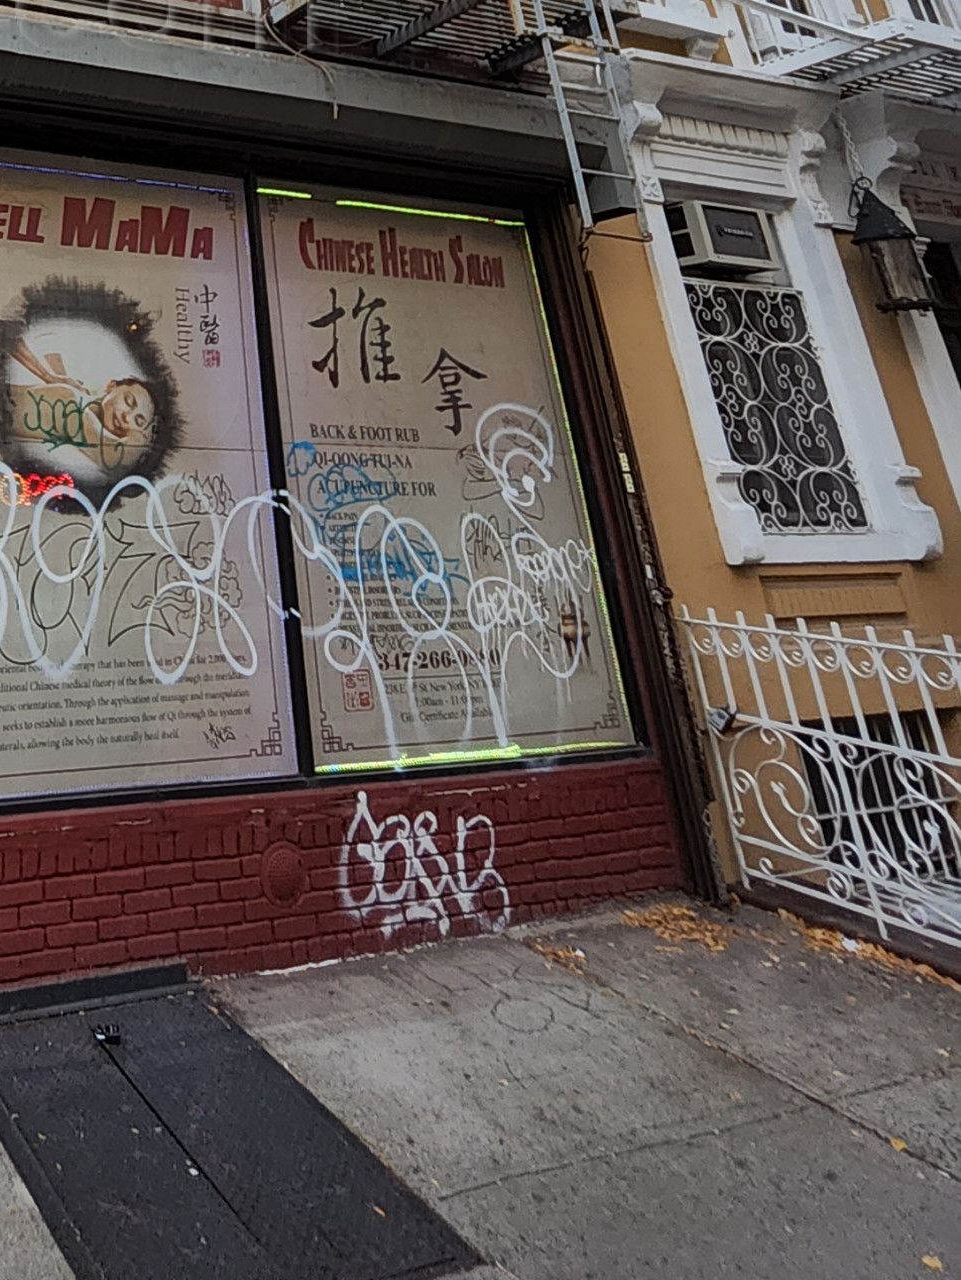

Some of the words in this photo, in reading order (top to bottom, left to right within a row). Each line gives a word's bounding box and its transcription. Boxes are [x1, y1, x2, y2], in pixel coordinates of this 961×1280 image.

[173, 288, 193, 364] Healthy
[308, 287, 488, 436] 推拿
[310, 424, 344, 438] BACK
[348, 426, 357, 439] &
[360, 426, 395, 441] FOOT
[396, 428, 419, 442] RUB
[412, 482, 437, 497] FOR
[98, 659, 112, 668] that
[114, 658, 126, 668] has
[127, 657, 144, 667] been
[164, 658, 172, 666] in
[30, 681, 60, 692] Chinese
[62, 679, 90, 689] medical
[93, 676, 115, 689] theory
[118, 675, 125, 686] of
[126, 675, 137, 685] the
[139, 674, 153, 684] flow
[203, 671, 214, 681] the
[430, 681, 446, 691] New
[64, 696, 96, 710] Through
[98, 695, 110, 705] the
[110, 693, 150, 708] application
[152, 691, 159, 702] of
[160, 693, 190, 704] massage
[191, 691, 203, 700] and
[204, 688, 250, 702] manipulation
[3, 720, 23, 732] seeks
[24, 721, 33, 730] to
[34, 717, 67, 729] establish
[75, 718, 94, 727] more
[95, 711, 139, 724] harmonious
[141, 710, 156, 721] flow
[158, 710, 165, 721] of
[167, 711, 176, 722] Qi
[178, 708, 206, 722] through
[207, 708, 218, 717] the
[219, 707, 243, 718] system
[244, 706, 251, 715] of
[26, 736, 60, 750] allowing
[62, 736, 74, 747] the
[76, 734, 95, 747] body
[110, 731, 142, 744] naturally
[144, 729, 160, 740] heal
